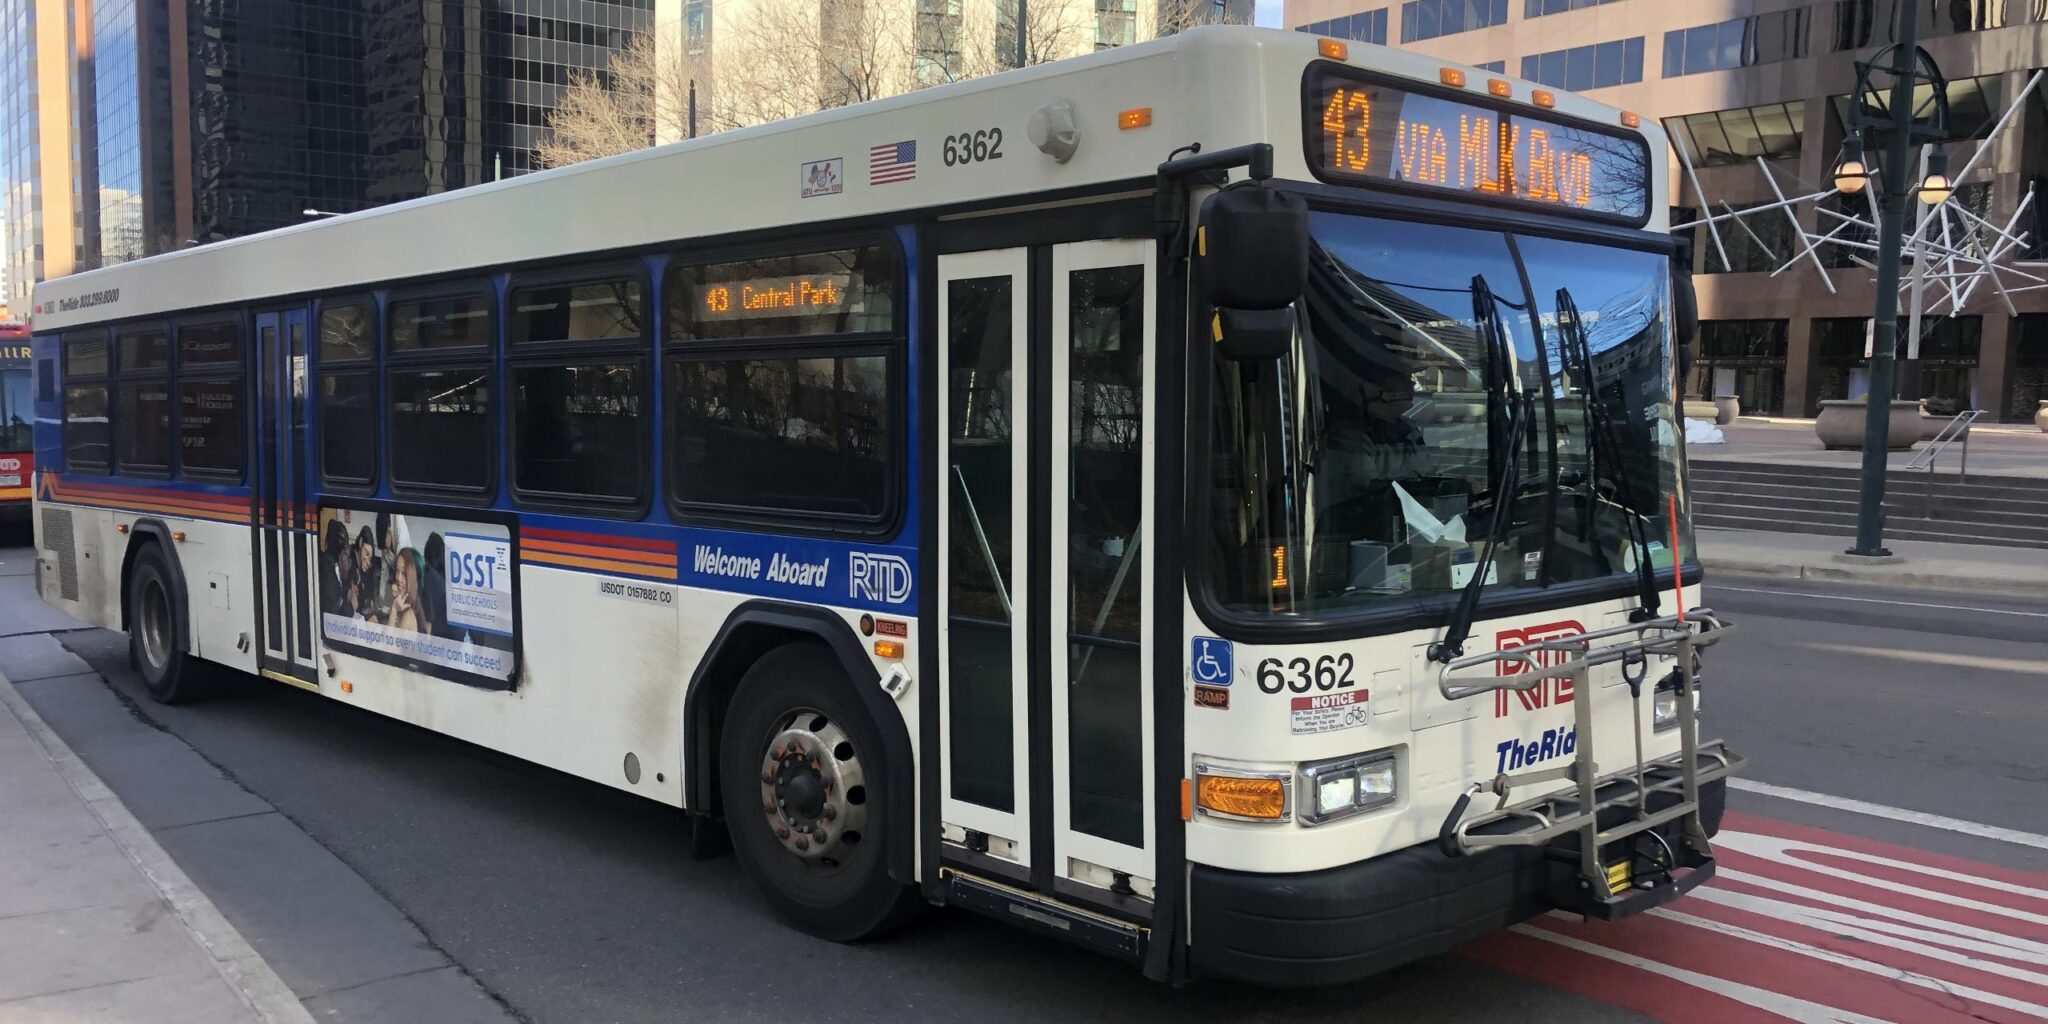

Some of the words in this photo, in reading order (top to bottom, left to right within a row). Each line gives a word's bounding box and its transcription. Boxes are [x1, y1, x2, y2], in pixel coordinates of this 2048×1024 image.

[943, 127, 1003, 167] 6362
[1323, 87, 1370, 171] 43
[1399, 119, 1447, 184] VIA
[1459, 113, 1520, 196] MLK
[707, 287, 729, 312] 43
[743, 282, 794, 310] Central
[800, 279, 838, 305] Park
[450, 551, 495, 589] DSST
[693, 544, 761, 580] Welcome
[766, 552, 830, 588] Aboard
[849, 551, 912, 604] RTD
[1272, 546, 1287, 588] 1
[450, 593, 471, 606] PUBLIC
[471, 596, 497, 610] SCHOOLS
[601, 581, 625, 596] USDOT
[627, 584, 658, 601] 0157882
[660, 592, 671, 603] CO
[325, 620, 358, 639] Individual
[359, 627, 385, 645] support
[385, 634, 394, 646] so
[395, 636, 417, 653] every
[417, 640, 447, 658] student
[447, 648, 463, 662] can
[464, 653, 501, 672] succeed
[877, 619, 906, 637] KNEELING
[1257, 652, 1355, 694] 6362
[1196, 690, 1227, 705] RAMP
[1311, 692, 1355, 709] NOTICE
[1496, 724, 1577, 774] TheRid
